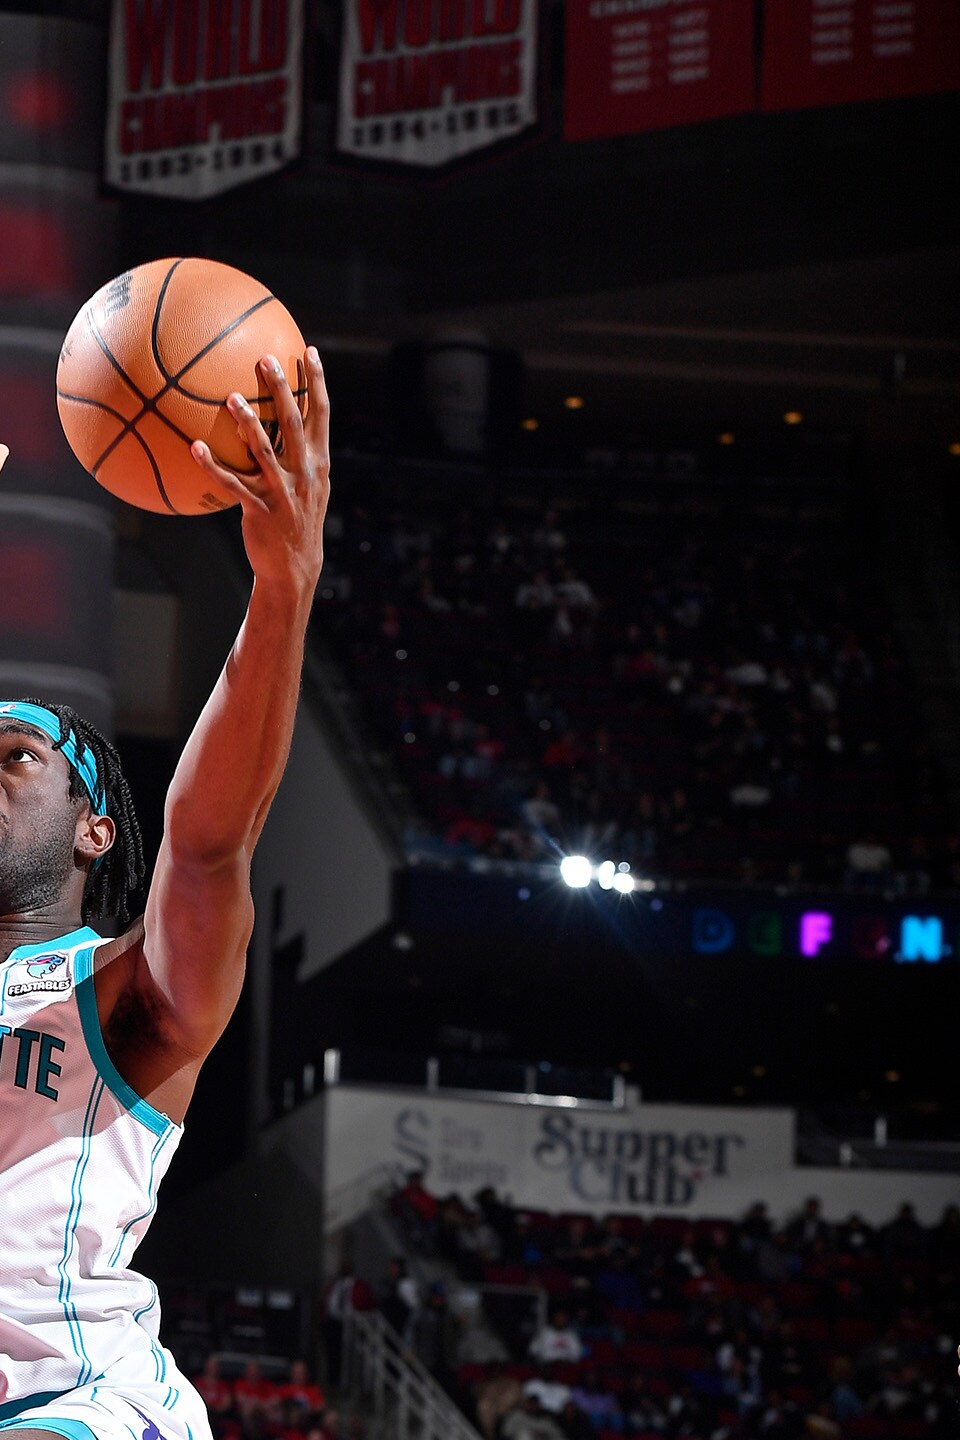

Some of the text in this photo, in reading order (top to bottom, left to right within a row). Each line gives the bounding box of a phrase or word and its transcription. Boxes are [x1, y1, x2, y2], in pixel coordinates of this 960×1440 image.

[692, 908, 944, 964] DEFEN
[7, 978, 71, 997] FEASTABLES
[534, 1112, 744, 1177] Supper
[570, 1157, 696, 1206] Club
